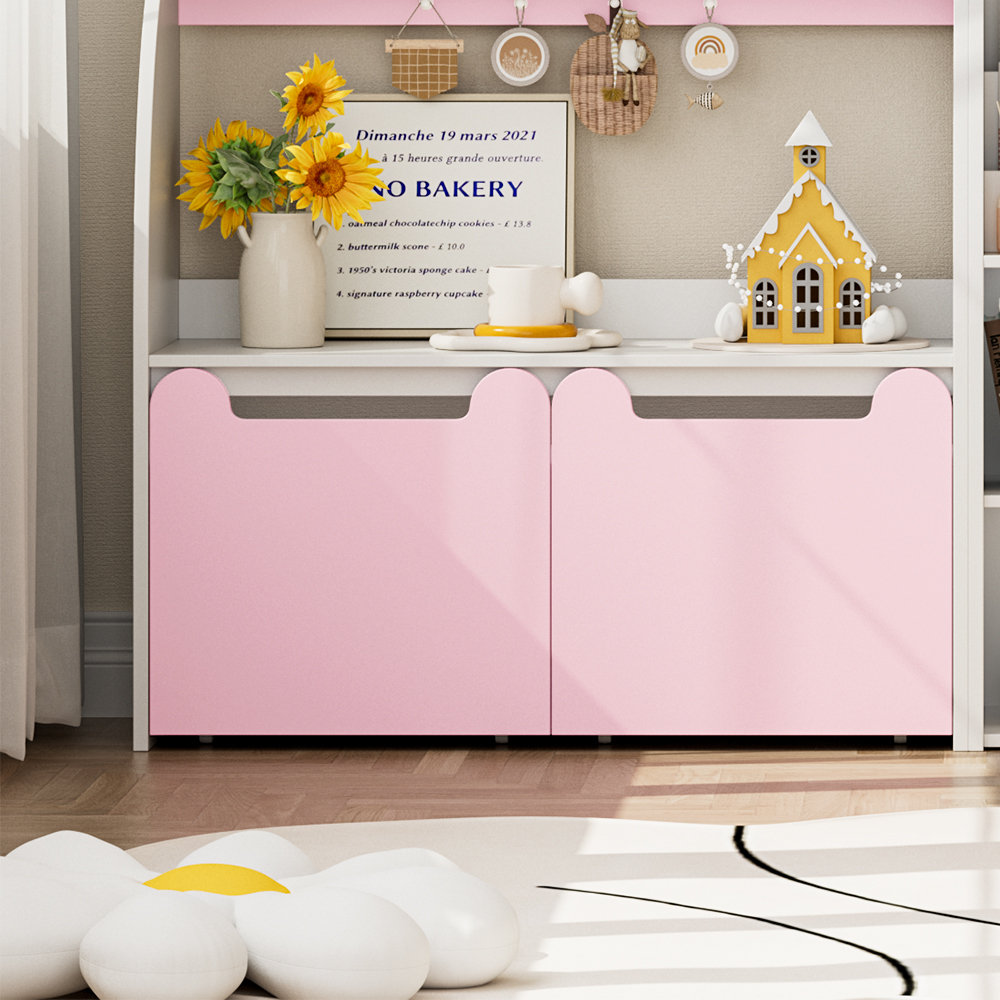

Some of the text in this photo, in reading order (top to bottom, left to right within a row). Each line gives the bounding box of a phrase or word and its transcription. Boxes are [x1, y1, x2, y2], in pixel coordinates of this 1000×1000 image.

[356, 129, 537, 142] Dimanche 19 mars 2021
[381, 153, 544, 165] à 15 heures grande ouverture.
[416, 180, 523, 198] BAKERY
[389, 219, 456, 229] chocolatechip
[458, 219, 495, 228] cookies
[337, 243, 345, 251] 2.
[348, 242, 400, 251] buttermilk
[447, 243, 465, 251] 10.0
[337, 266, 345, 275] 3.
[348, 266, 377, 275] 1950's
[379, 266, 416, 275] victoria
[418, 267, 452, 276] sponge
[455, 266, 477, 275] cake
[336, 290, 484, 300] 4. signature raspberry cupcake
